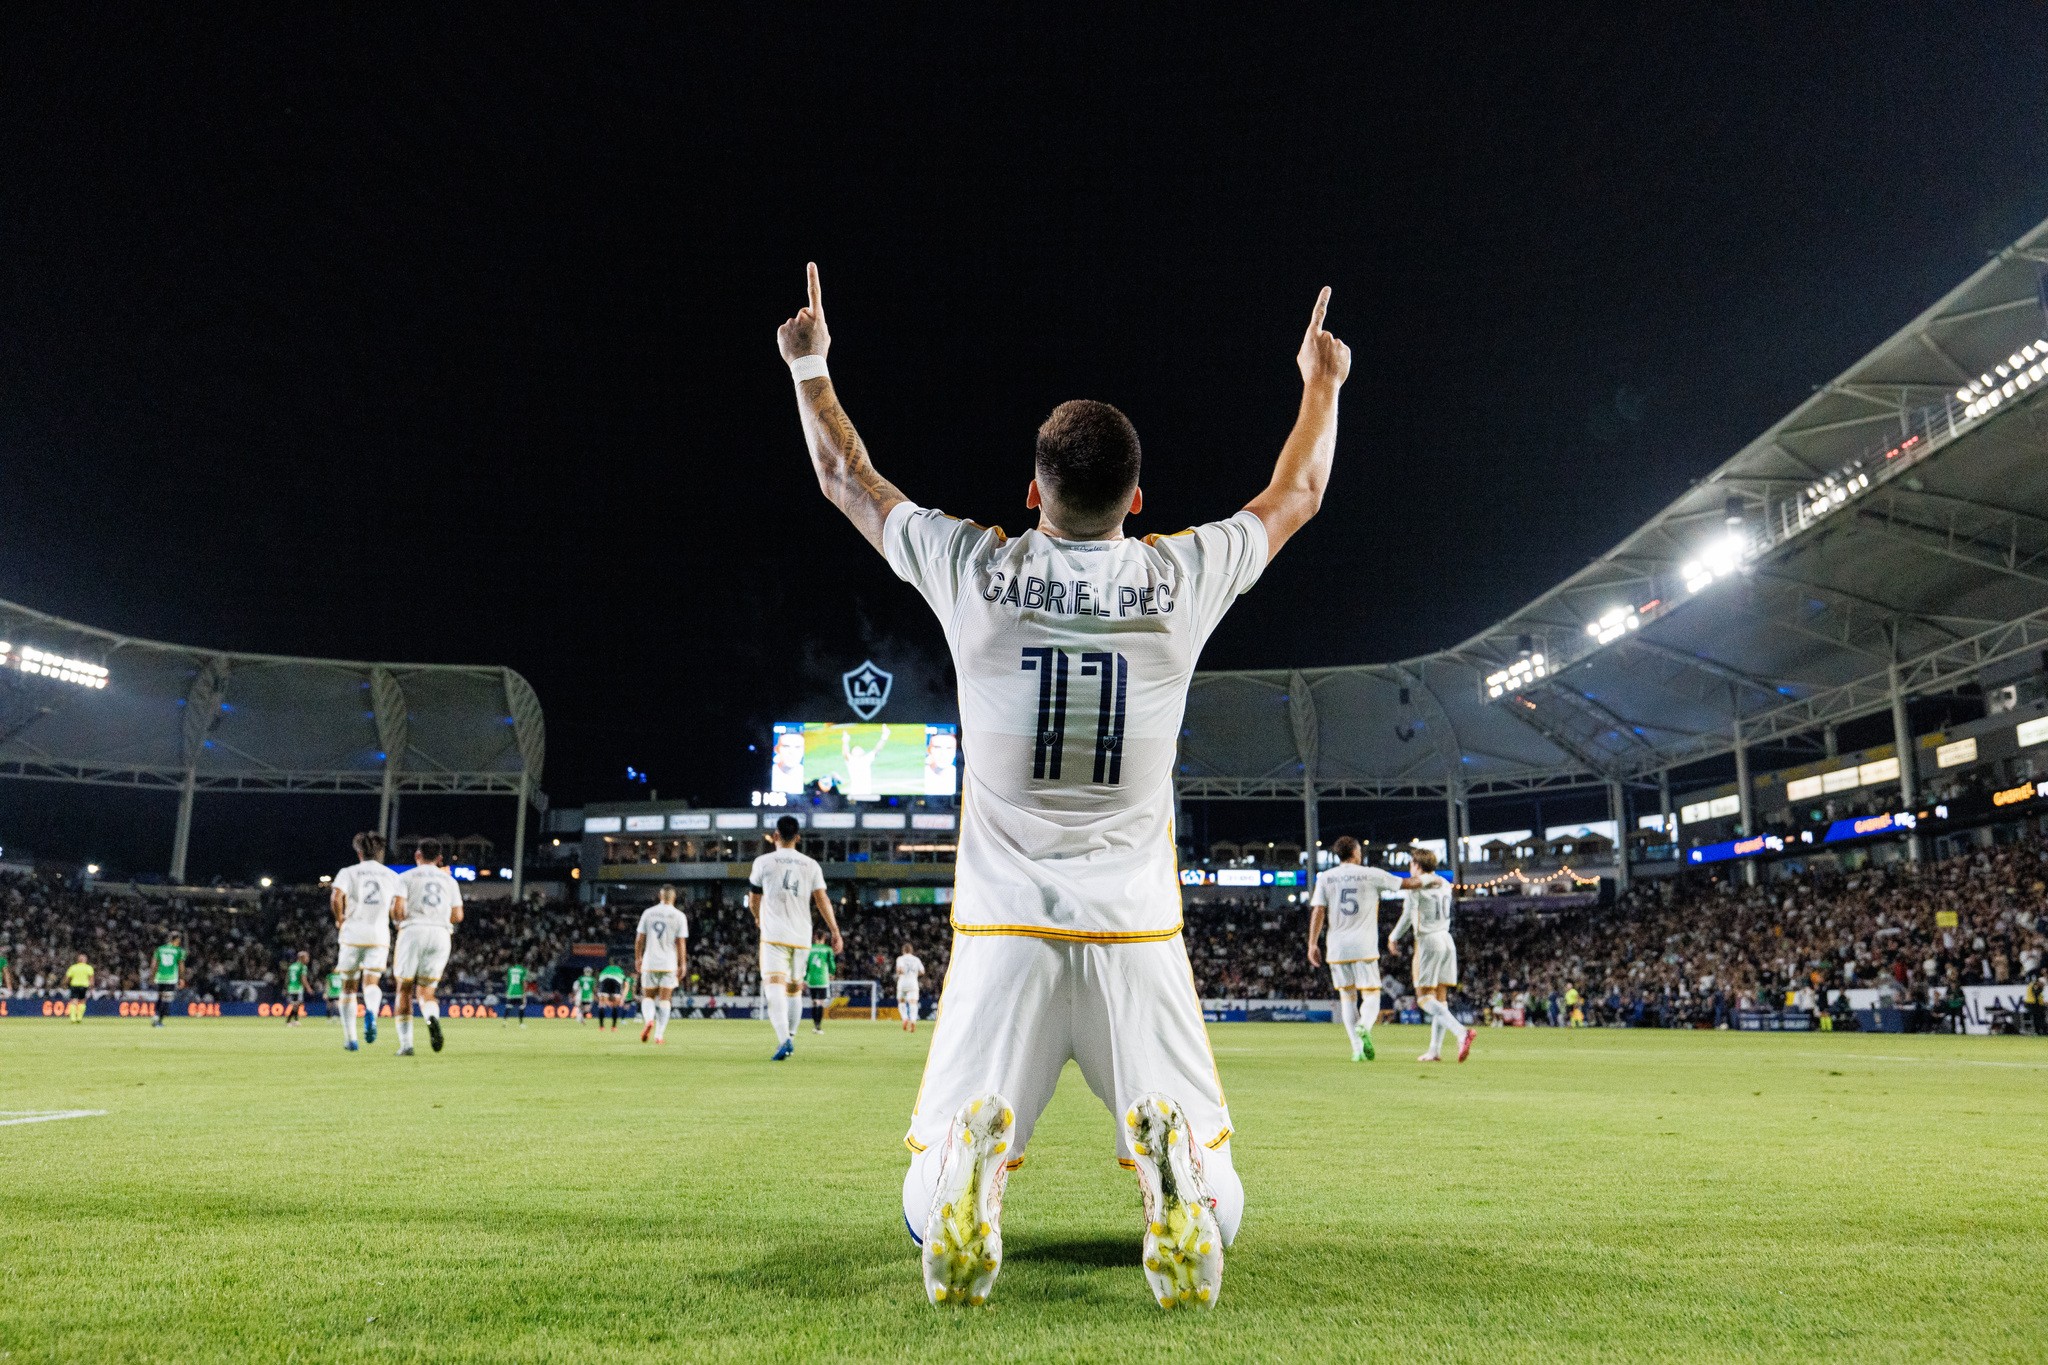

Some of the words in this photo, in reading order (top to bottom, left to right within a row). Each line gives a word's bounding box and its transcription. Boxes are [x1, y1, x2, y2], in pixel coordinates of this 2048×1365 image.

[982, 572, 1110, 617] GABRIEL
[1119, 583, 1174, 617] PEC
[854, 680, 881, 697] LA
[1021, 647, 1128, 784] 11
[363, 880, 379, 905] 2
[423, 881, 441, 907] 8
[782, 869, 799, 897] 4
[1340, 888, 1359, 916] 5
[653, 920, 667, 939] 9
[119, 1002, 156, 1016] GOAL
